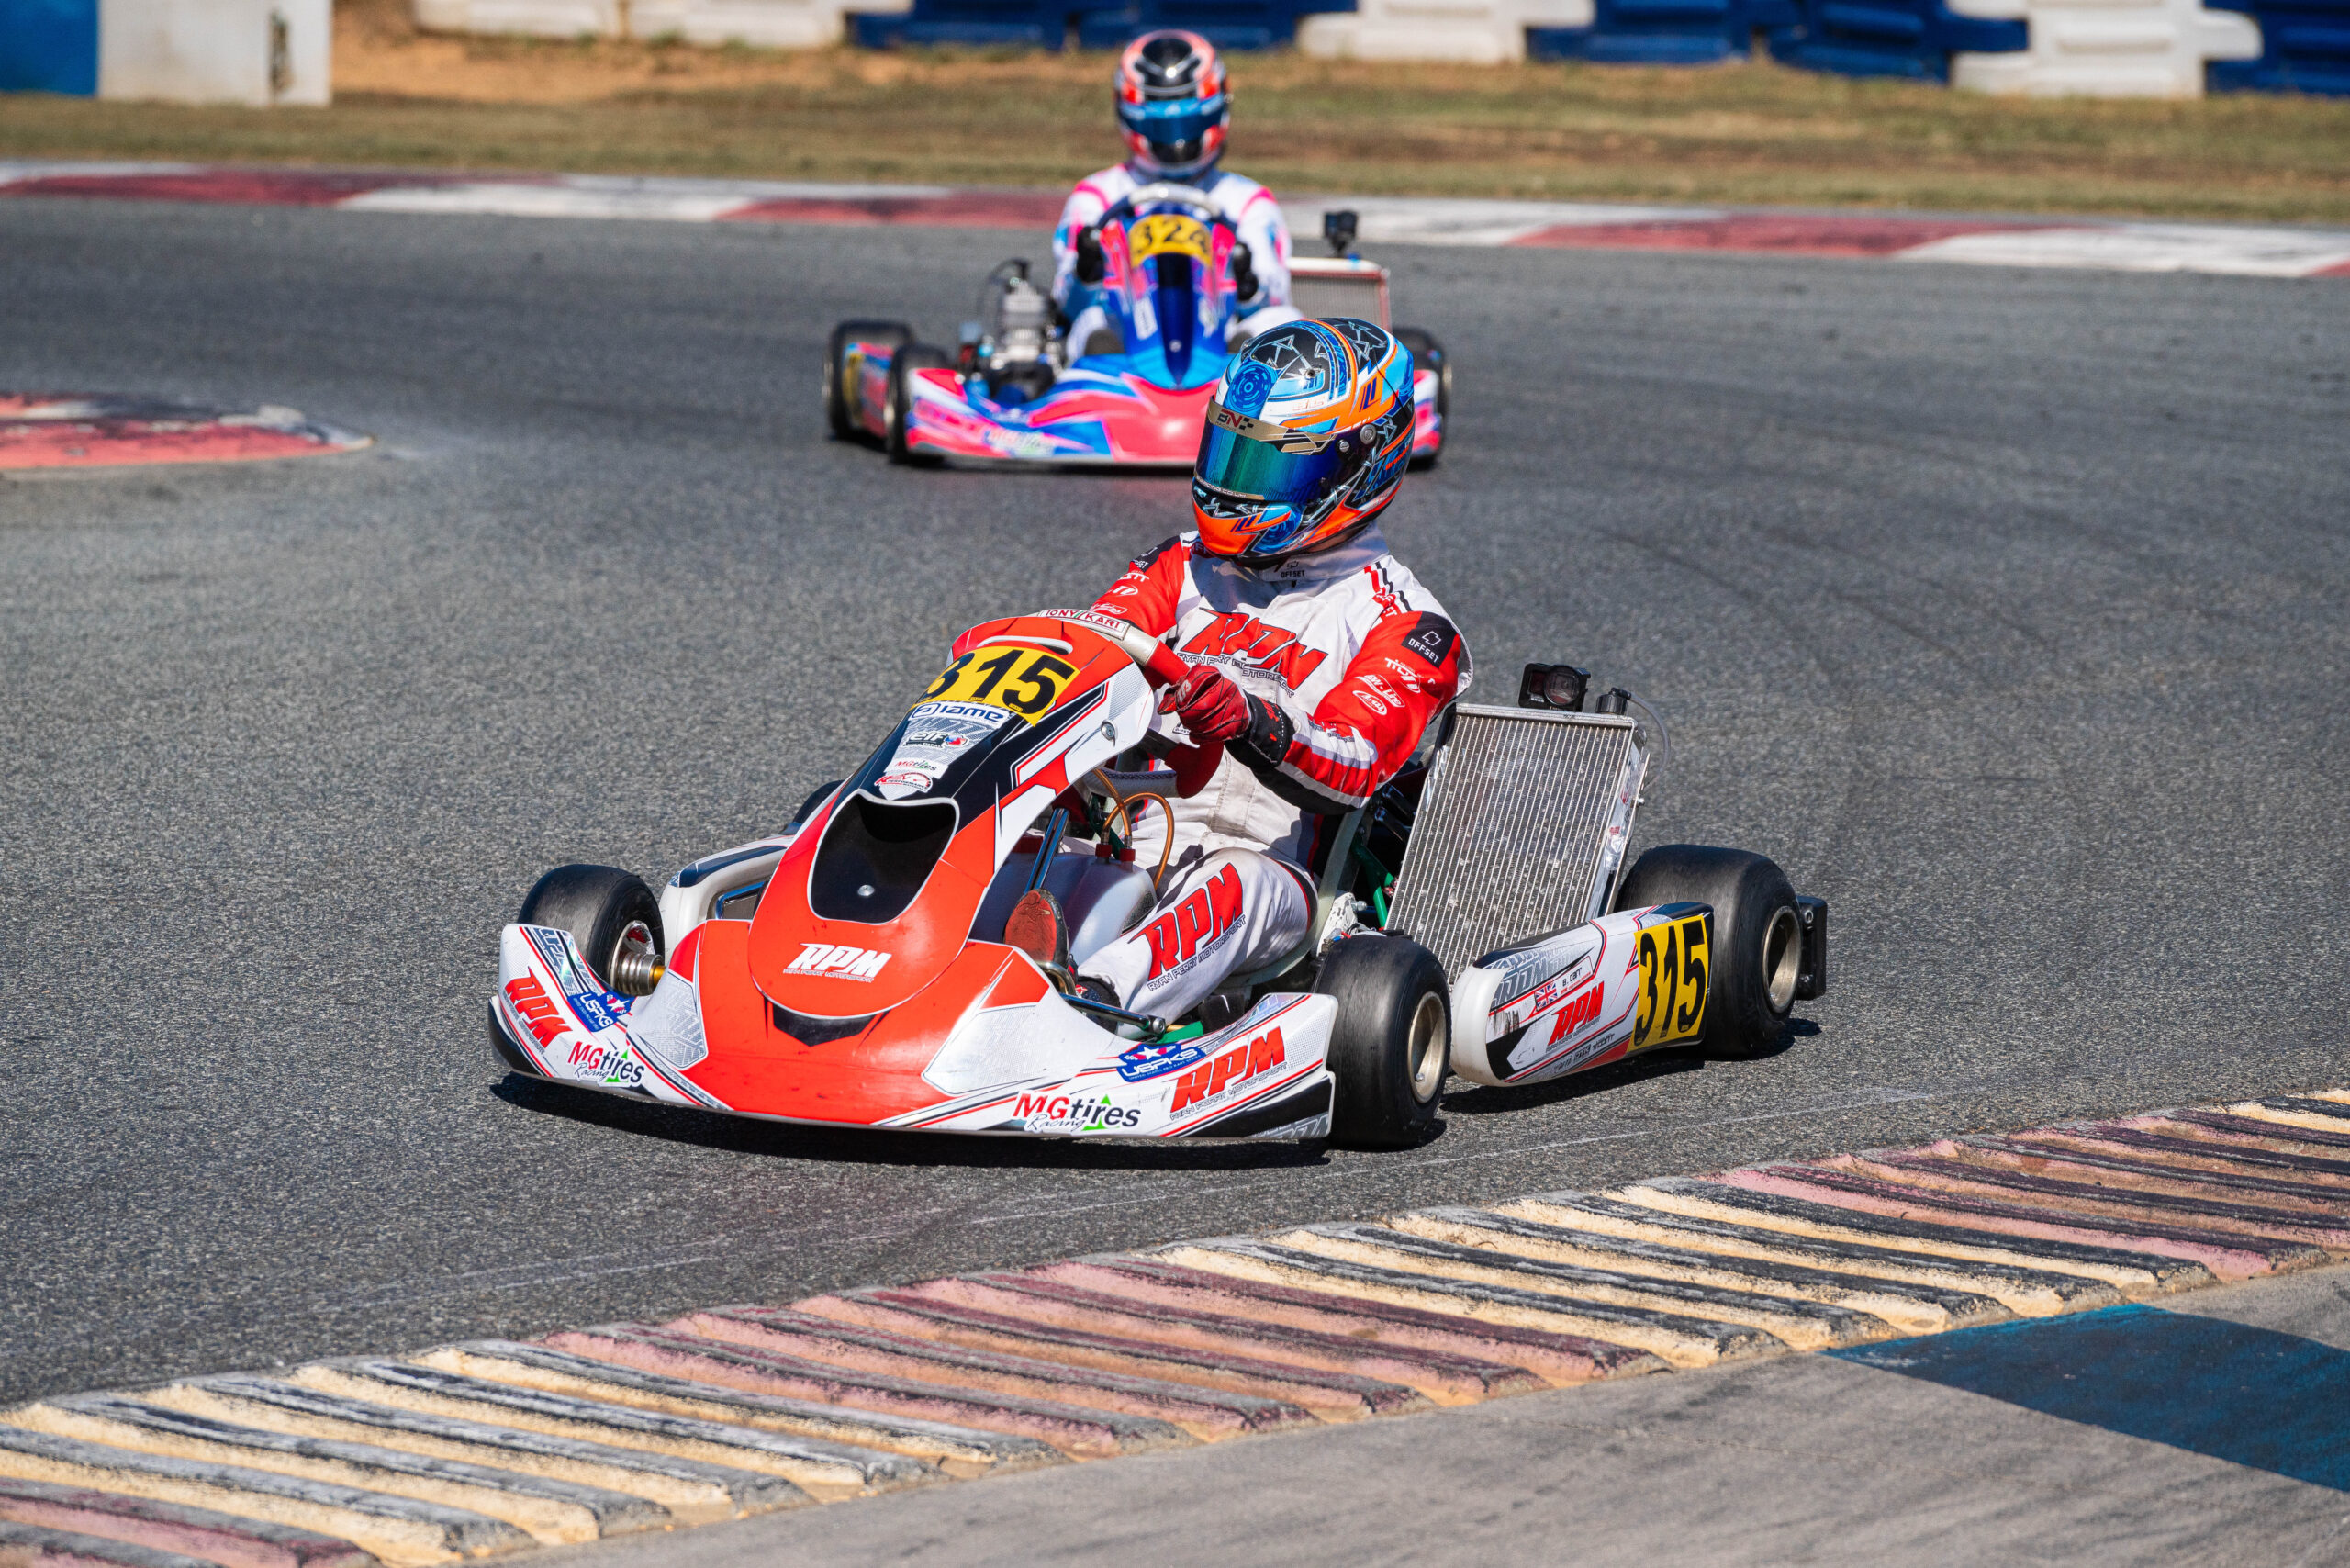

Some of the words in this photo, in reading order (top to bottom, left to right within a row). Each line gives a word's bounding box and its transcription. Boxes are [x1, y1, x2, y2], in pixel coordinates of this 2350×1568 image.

[1281, 570, 1304, 578] OFFSET
[1084, 611, 1121, 629] KART
[1176, 653, 1207, 666] RYAN
[1180, 607, 1328, 690] RPM
[1407, 637, 1440, 664] OFFSET
[918, 649, 1076, 714] 315
[1127, 862, 1244, 981] RPM
[787, 943, 892, 978] RPM
[1147, 972, 1174, 991] RYAN
[1171, 956, 1197, 980] PERRY
[1198, 915, 1247, 964] MOTORSPORT
[1634, 919, 1706, 1046] 315
[505, 966, 574, 1049] RPM
[579, 993, 614, 1027] USPKS
[1547, 980, 1605, 1046] RPM
[567, 1040, 645, 1083] MGtires
[1121, 1046, 1199, 1077] USPKS
[1161, 1025, 1285, 1114] RPM
[1013, 1092, 1142, 1128] MGtires
[1027, 1114, 1087, 1132] Racing
